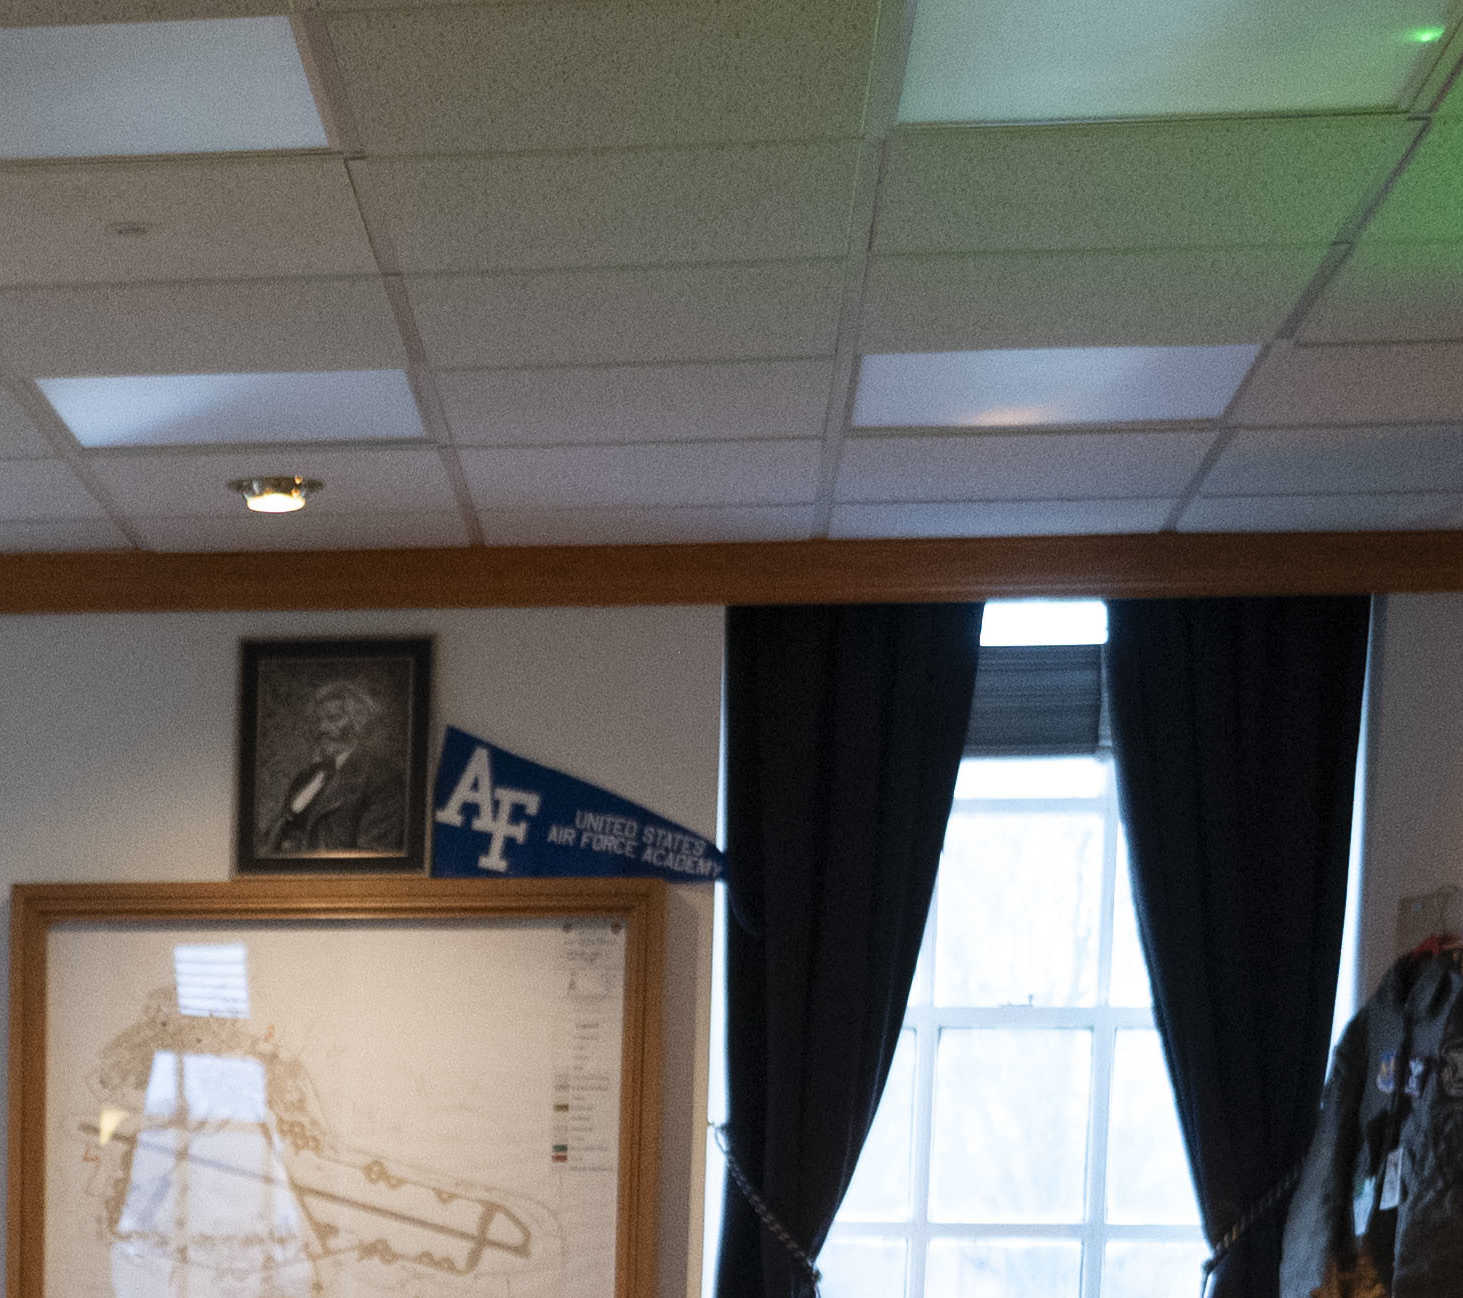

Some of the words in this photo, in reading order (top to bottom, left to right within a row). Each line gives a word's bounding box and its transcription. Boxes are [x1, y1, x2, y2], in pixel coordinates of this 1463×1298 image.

[435, 746, 541, 873] AF
[576, 811, 637, 837] UNITED
[642, 826, 705, 856] STATES
[548, 825, 576, 846] AIR
[581, 832, 637, 857] FORCE
[642, 847, 722, 878] ACADEMY
